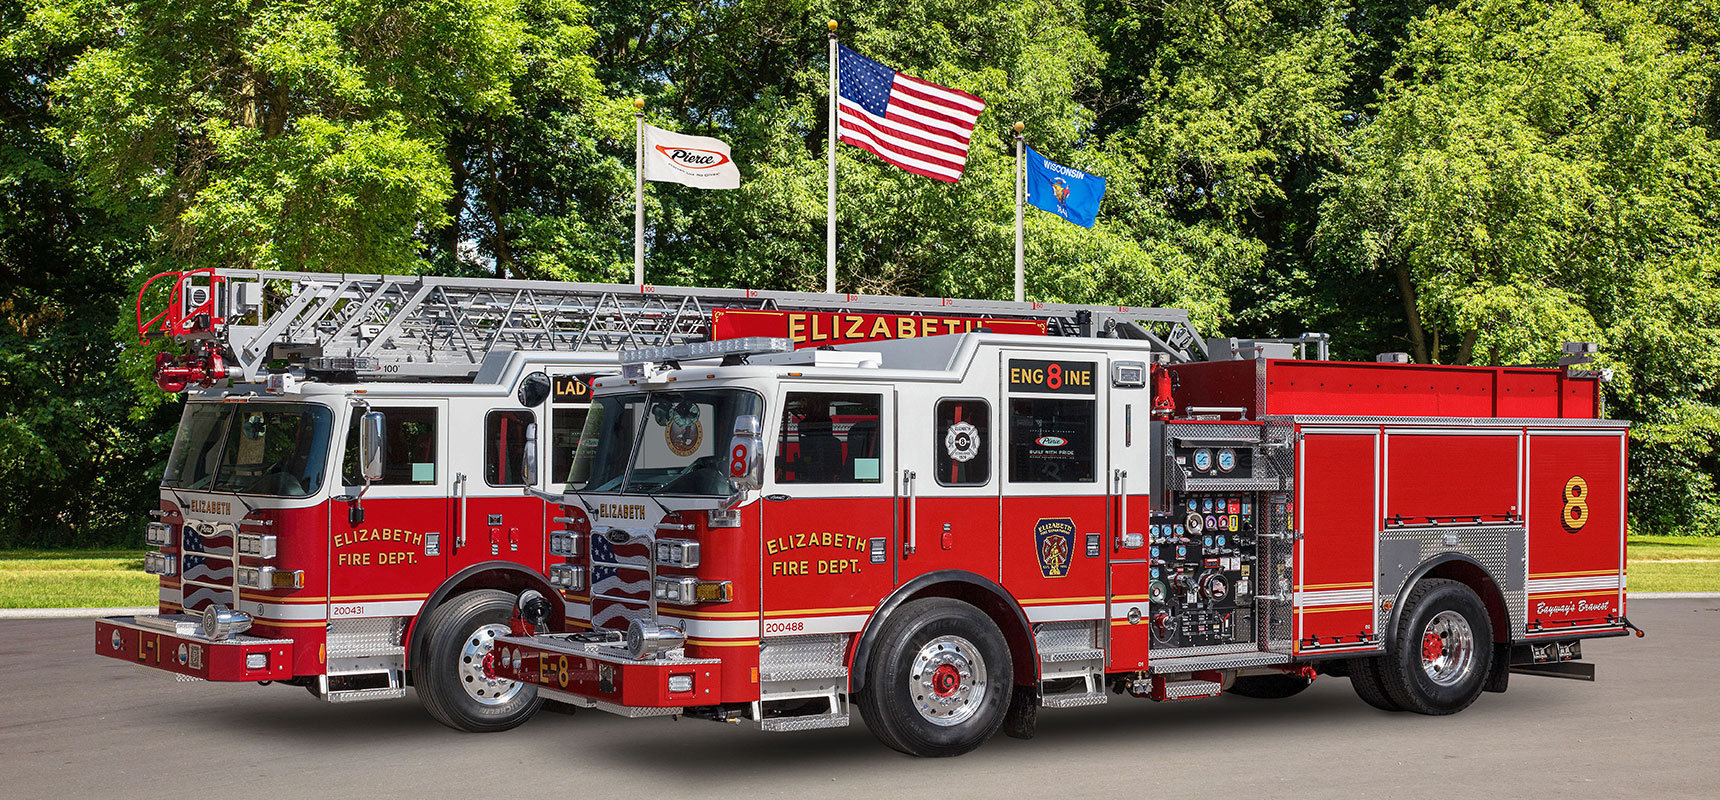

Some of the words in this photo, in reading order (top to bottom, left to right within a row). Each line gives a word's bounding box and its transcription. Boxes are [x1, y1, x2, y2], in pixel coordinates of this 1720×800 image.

[671, 149, 714, 164] Pierce
[1043, 159, 1085, 180] WISCONSIN
[850, 294, 858, 302] 80
[1011, 367, 1044, 385] ENG
[1046, 363, 1062, 390] 8
[1065, 370, 1091, 386] INE
[556, 380, 587, 395] LAD
[960, 438, 967, 446] 8
[731, 444, 747, 477] 8
[191, 499, 231, 516] ELIZABETH
[600, 503, 646, 520] ELIZABETH
[1560, 475, 1589, 534] 8
[1038, 522, 1072, 532] ELIZABETH
[333, 528, 422, 548] ELIZABETH
[766, 532, 867, 555] ELIZABETH
[338, 553, 371, 567] FIRE
[377, 552, 418, 566] DEPT.
[772, 560, 809, 576] FIRE
[816, 559, 862, 575] DEPT.
[333, 606, 364, 615] 200431
[1536, 601, 1576, 617] Bayway's
[1578, 599, 1610, 612] Bravest
[765, 621, 804, 633] 200488
[138, 630, 160, 664] L-1
[538, 651, 569, 689] E-8
[478, 698, 525, 716] MICHELIN
